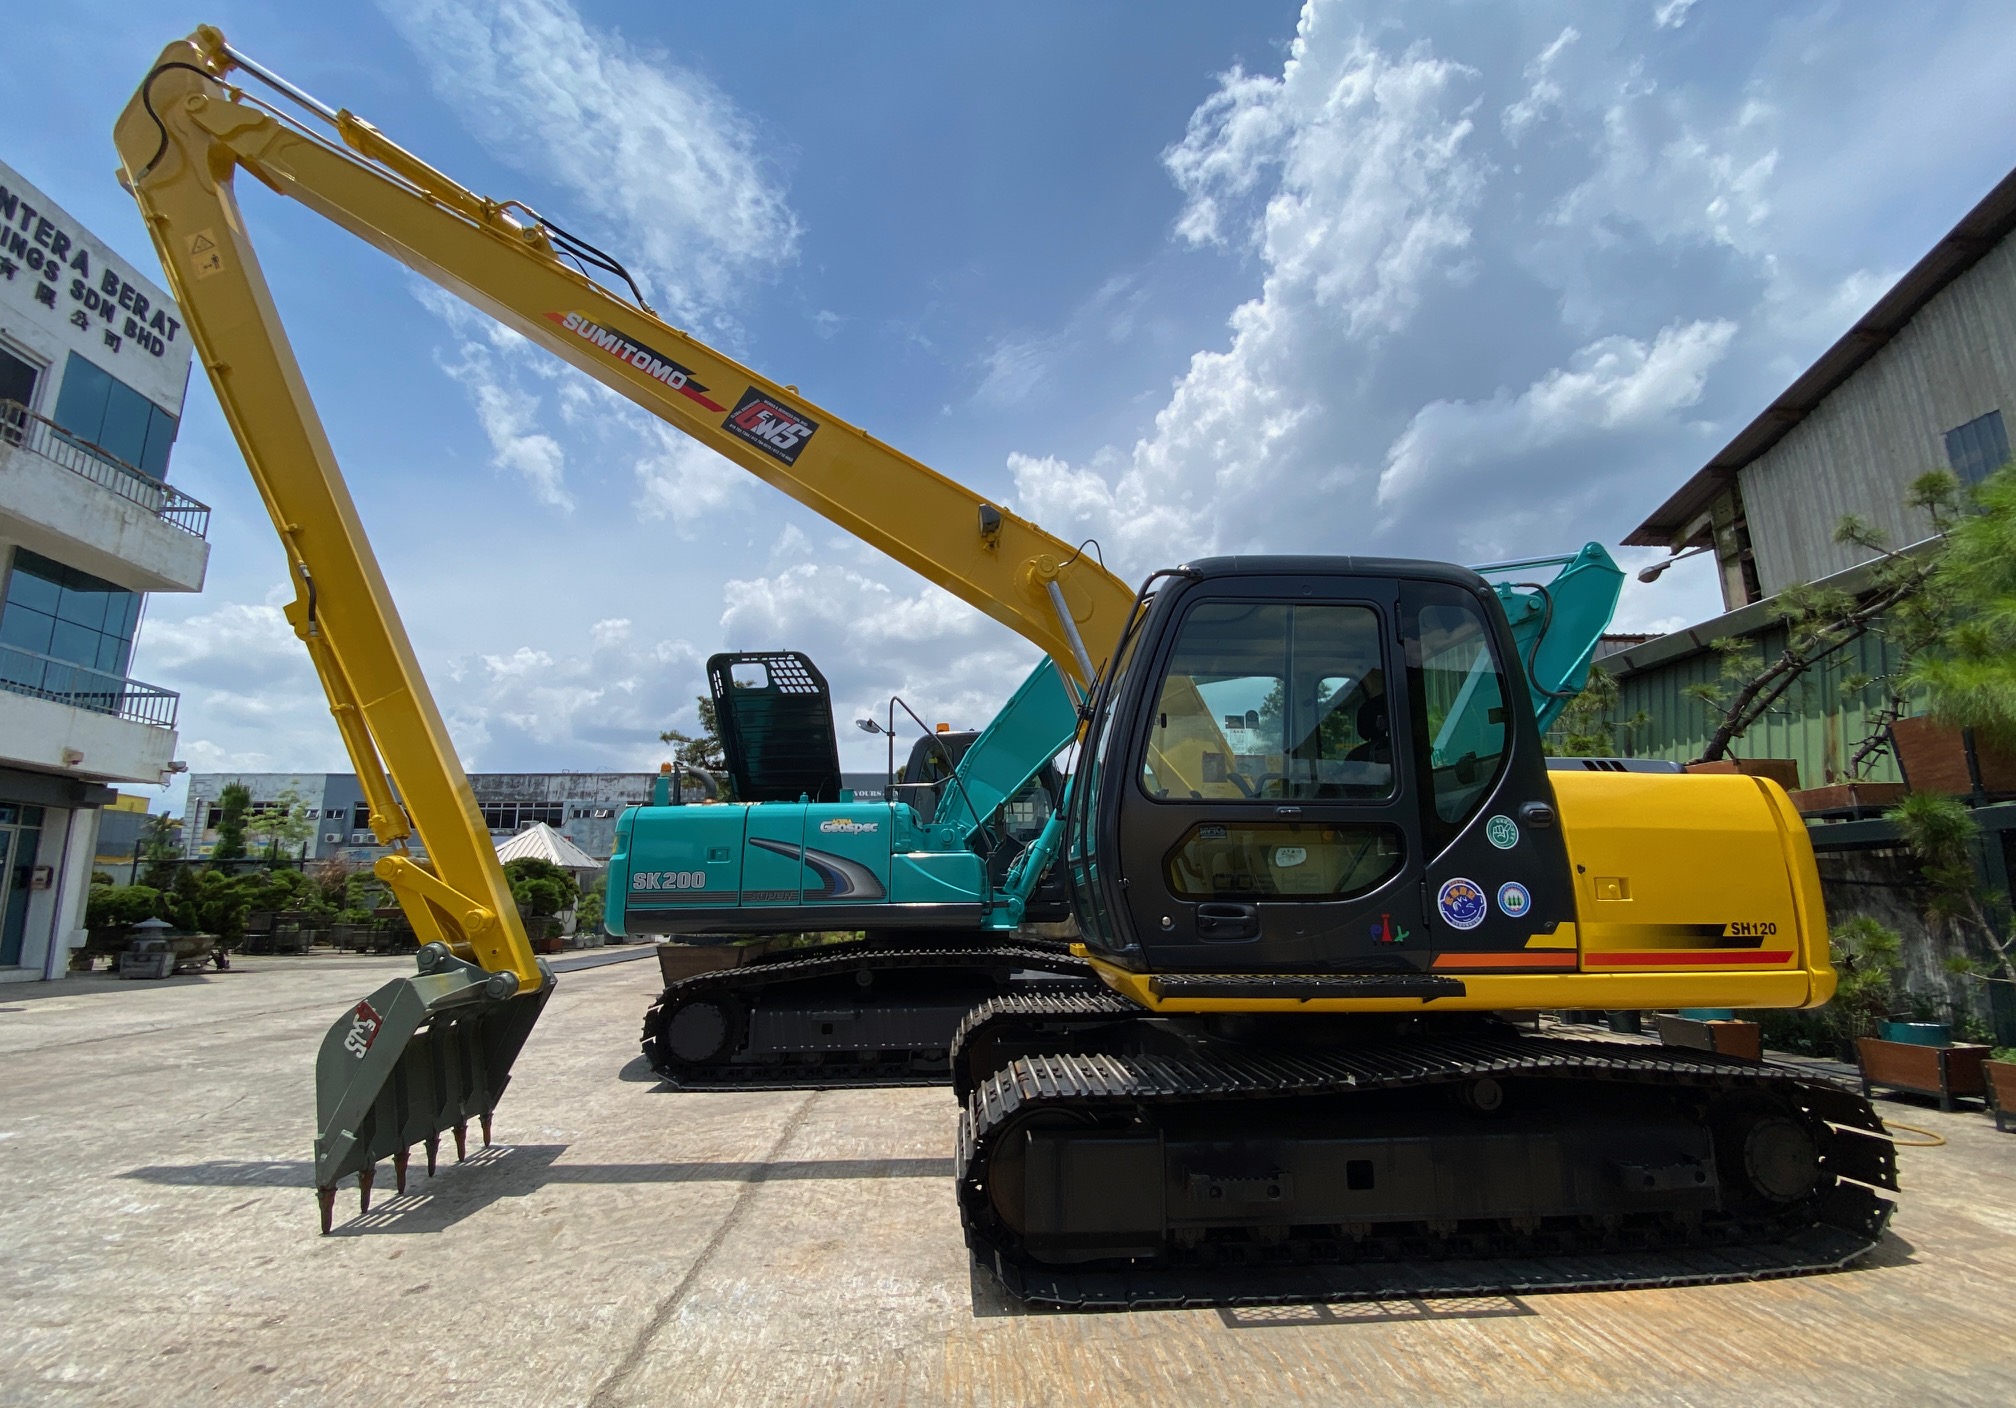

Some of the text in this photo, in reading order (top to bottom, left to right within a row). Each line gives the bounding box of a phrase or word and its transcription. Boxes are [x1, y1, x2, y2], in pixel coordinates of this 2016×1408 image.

[70, 279, 116, 323] SDN
[124, 316, 165, 357] BHD
[102, 268, 181, 342] BERAT
[562, 310, 688, 391] SUMITOMO
[820, 821, 879, 835] Geospec
[632, 871, 706, 890] SK200
[1731, 922, 1777, 936] SH120
